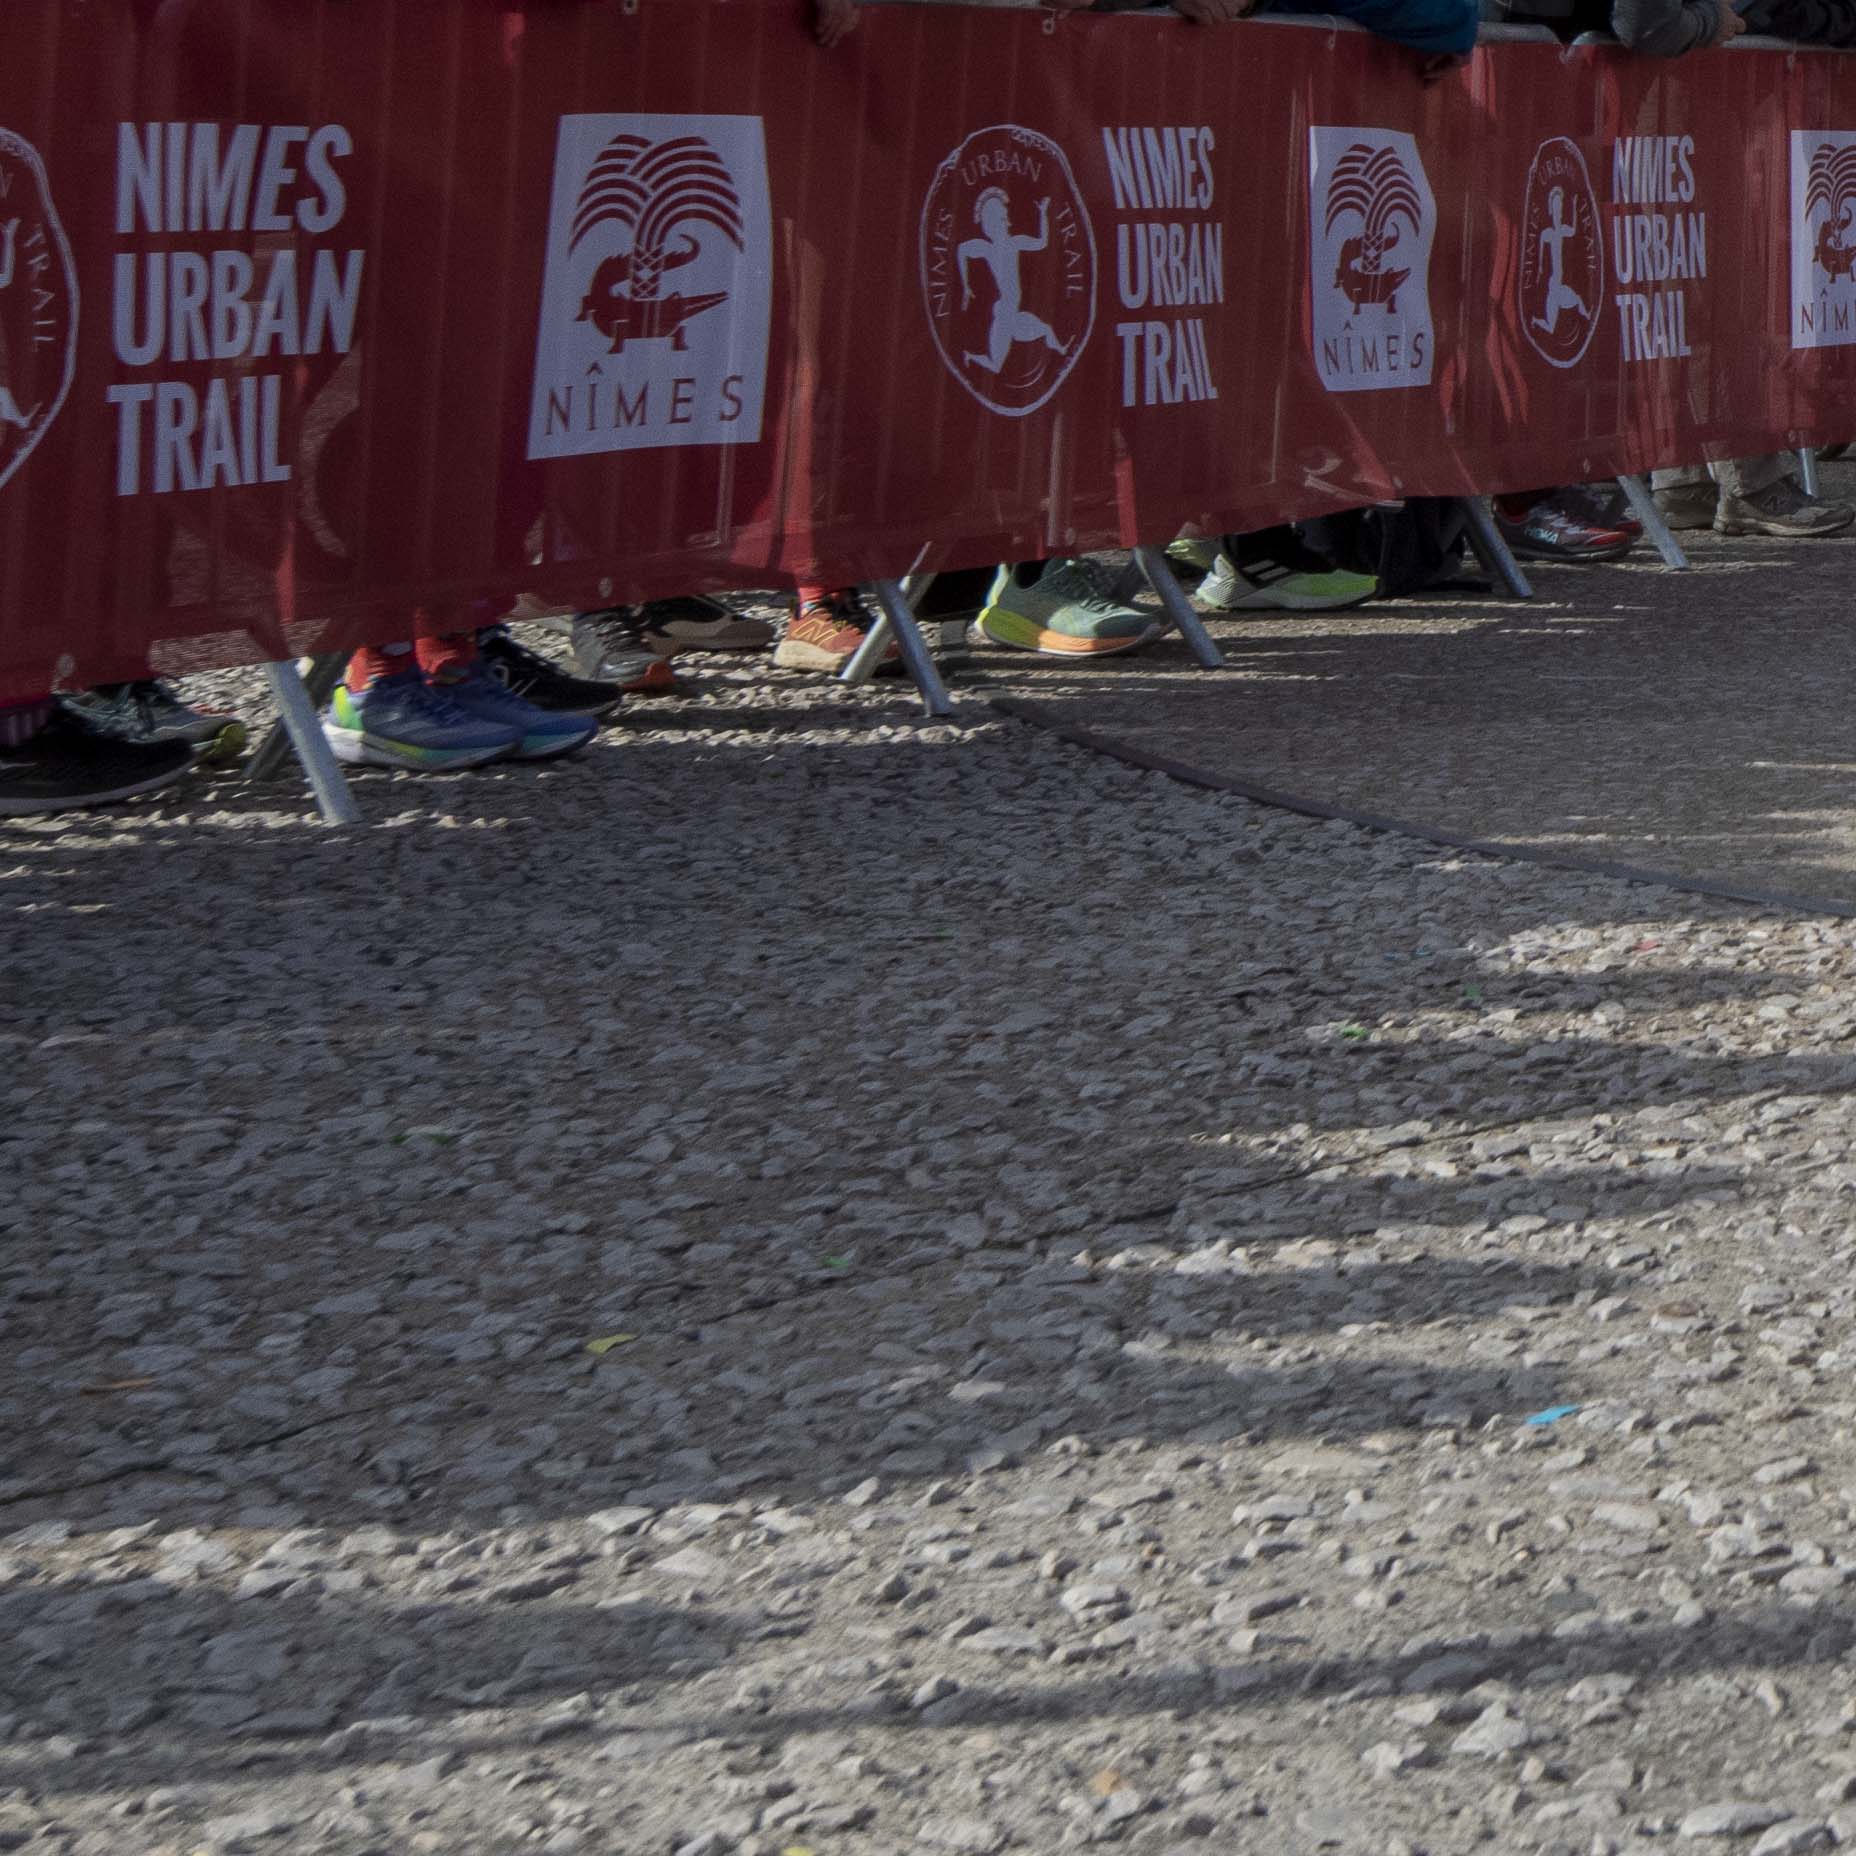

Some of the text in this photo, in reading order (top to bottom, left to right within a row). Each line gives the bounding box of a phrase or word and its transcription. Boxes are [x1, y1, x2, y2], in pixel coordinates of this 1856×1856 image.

[115, 122, 354, 233] NIMES
[1102, 127, 1215, 210] NIMES
[1612, 135, 1695, 204] NIMES
[961, 149, 1042, 186] URBAN
[1055, 201, 1083, 299] TRAIL
[1116, 223, 1224, 309] URBAN
[1613, 212, 1707, 284] URBAN
[113, 249, 366, 366] URBAN
[1321, 321, 1425, 377] NÎMES
[1615, 291, 1692, 361] TRAIL
[543, 362, 745, 436] NÎMES
[1114, 319, 1218, 407] TRAIL
[106, 375, 292, 496] TRAIL
